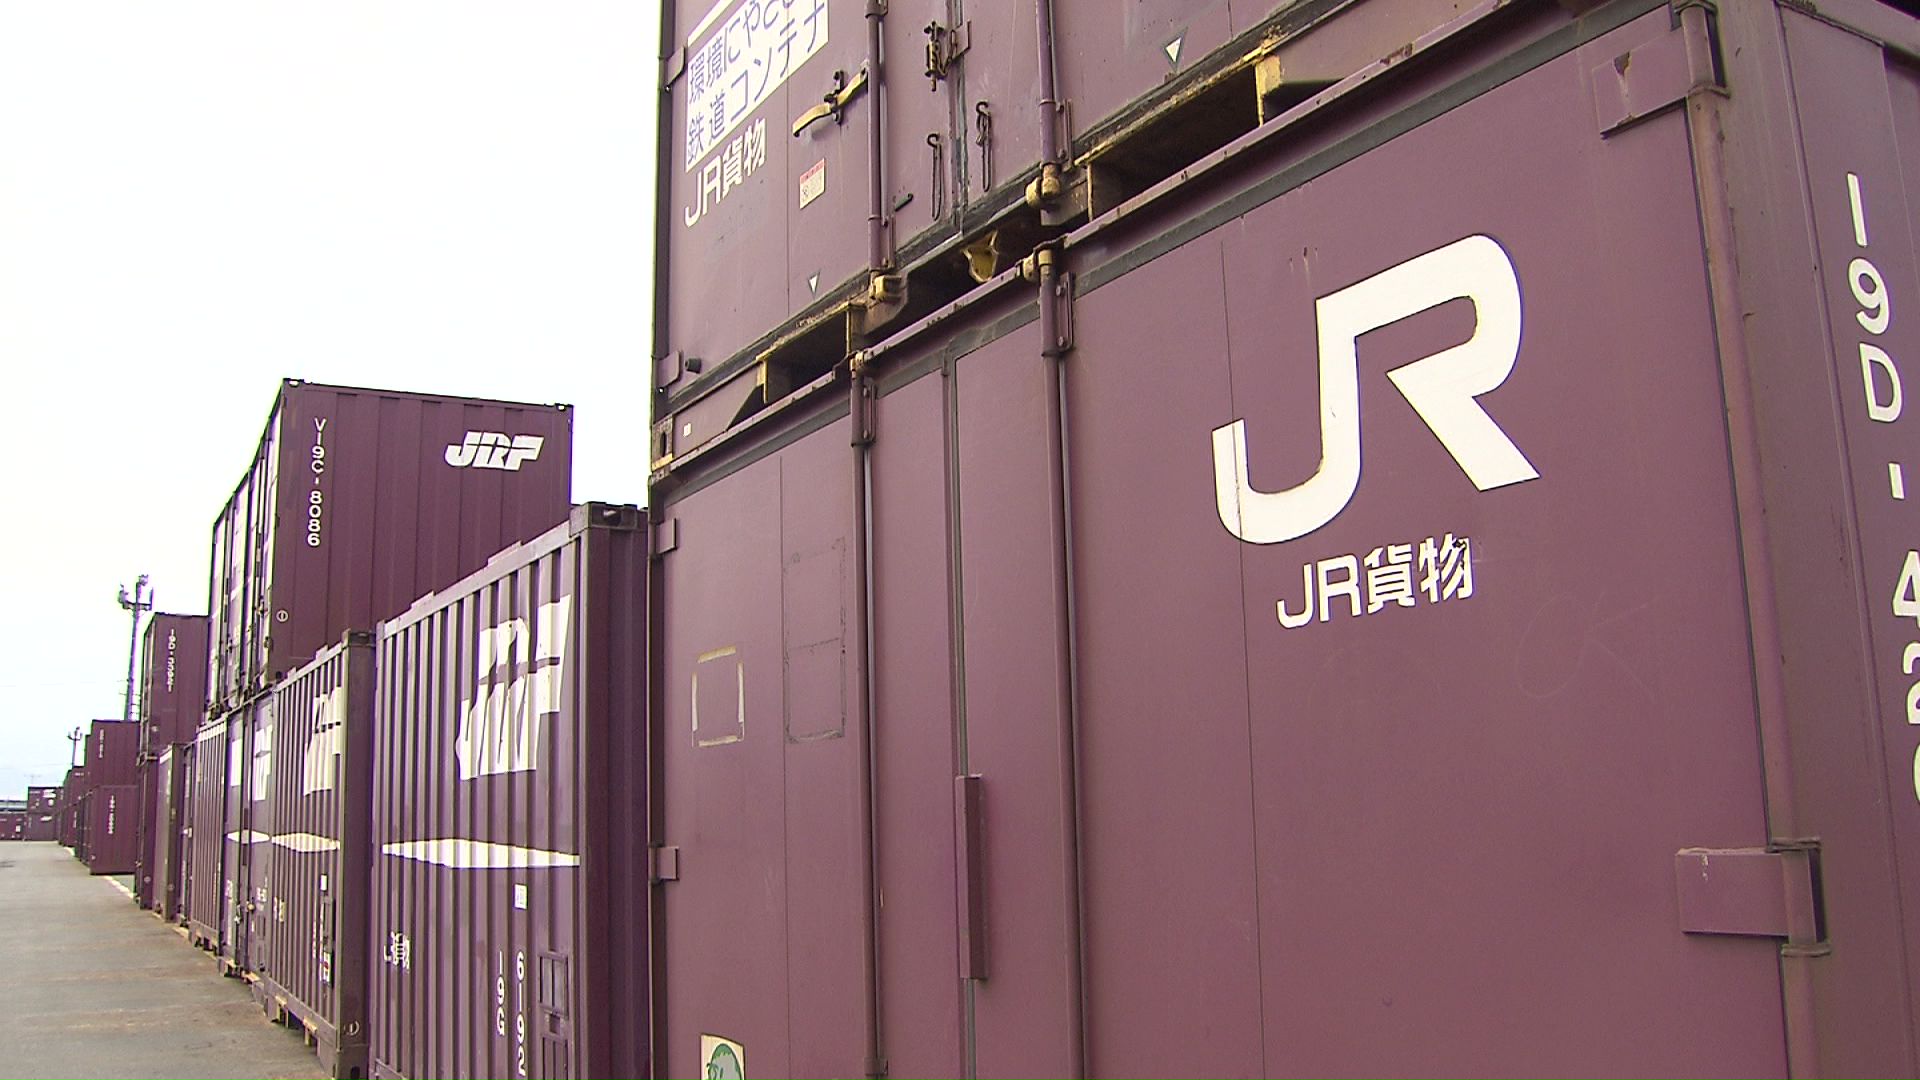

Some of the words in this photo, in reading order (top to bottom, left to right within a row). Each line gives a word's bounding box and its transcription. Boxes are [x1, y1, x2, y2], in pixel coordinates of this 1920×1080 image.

[687, 0, 825, 165] 鉄道コンテナ
[690, 0, 797, 104] 環境にや
[684, 117, 767, 228] JR貨物
[1211, 233, 1541, 545] JR
[306, 417, 326, 547] V19C-8086
[444, 431, 545, 471] JRF
[1276, 532, 1475, 629] JR貨物
